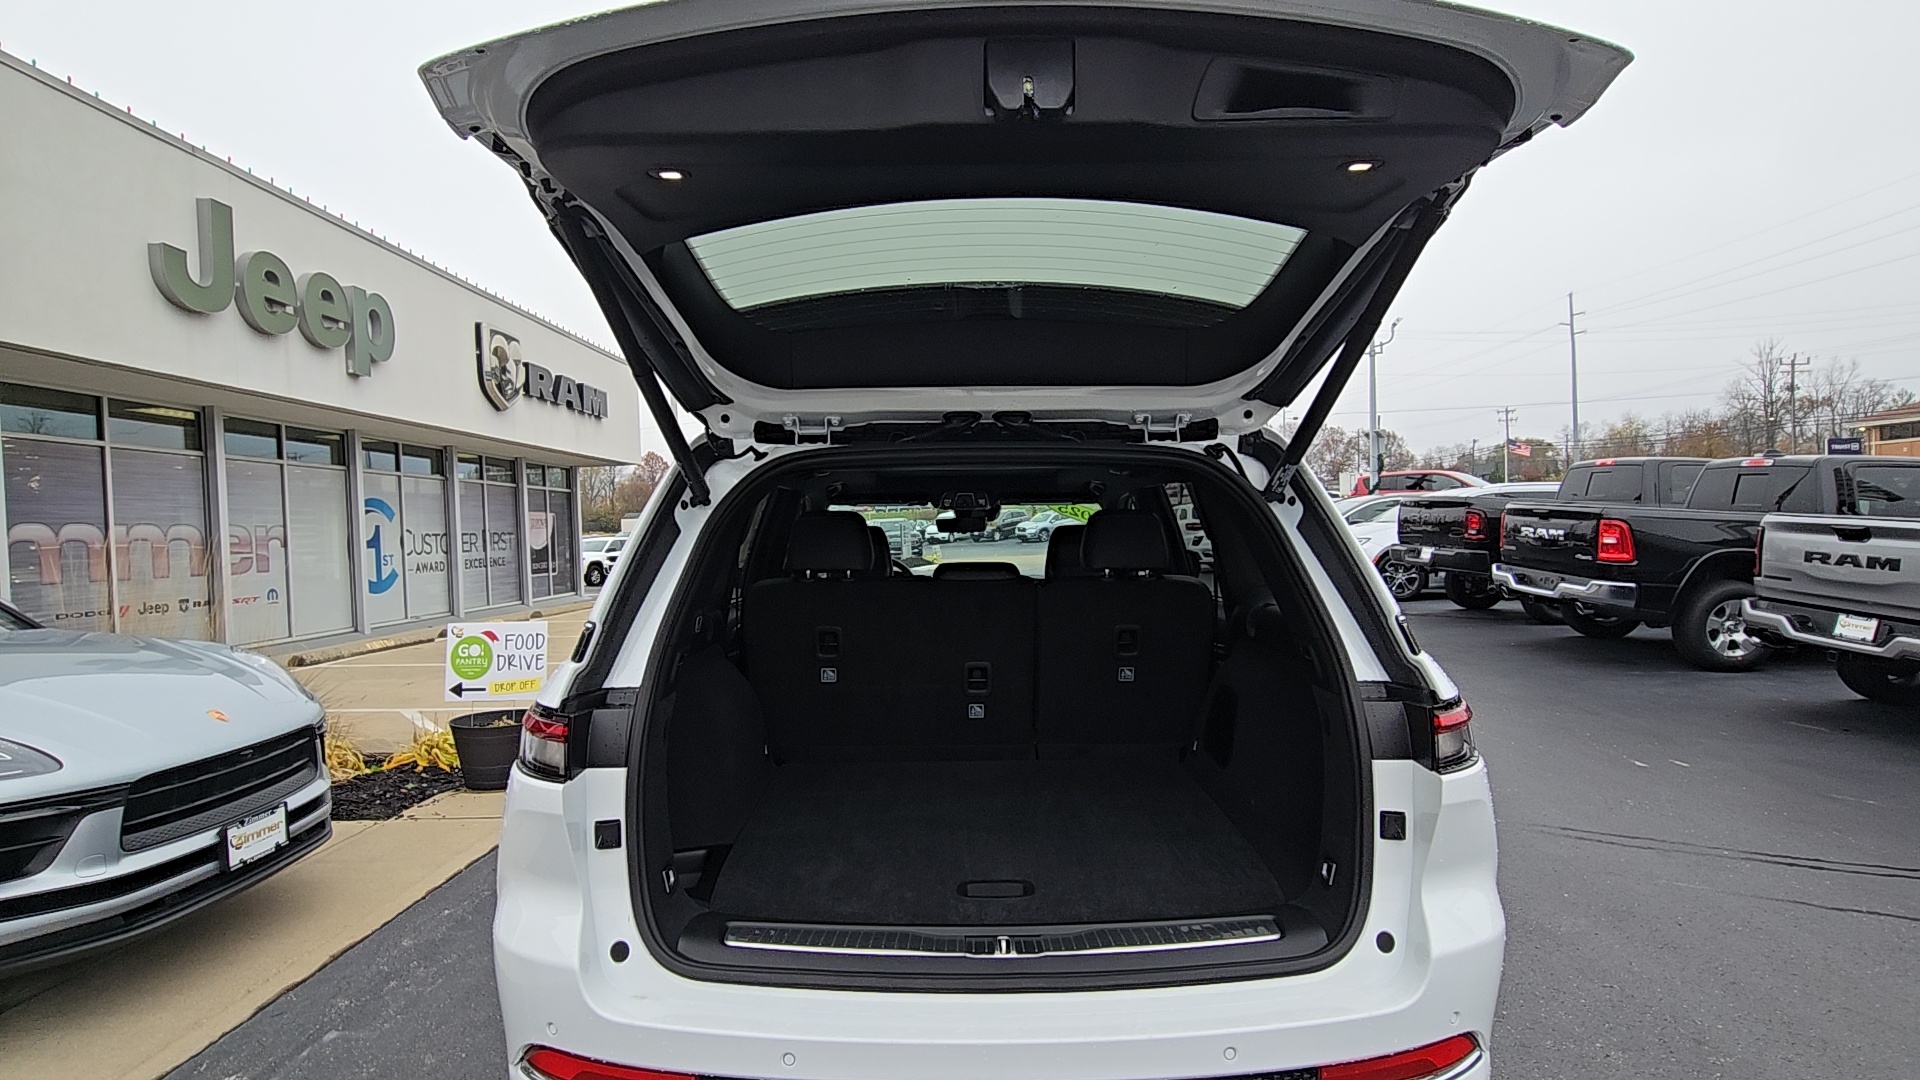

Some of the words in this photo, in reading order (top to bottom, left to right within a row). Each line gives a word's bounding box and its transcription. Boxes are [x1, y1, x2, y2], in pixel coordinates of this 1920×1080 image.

[148, 197, 396, 378] Jeep
[522, 361, 609, 420] RAM
[1410, 512, 1447, 525] RAM
[1520, 526, 1566, 541] RAM
[415, 561, 446, 574] AWARD
[464, 556, 506, 570] EXCELENCE
[1803, 550, 1902, 573] RAM
[232, 595, 260, 605] SRT
[137, 601, 169, 616] Jeep
[504, 632, 546, 651] FOOD
[458, 643, 486, 657] GO!
[496, 653, 545, 672] DRIVE
[494, 682, 516, 693] DROP
[519, 679, 537, 690] OFF
